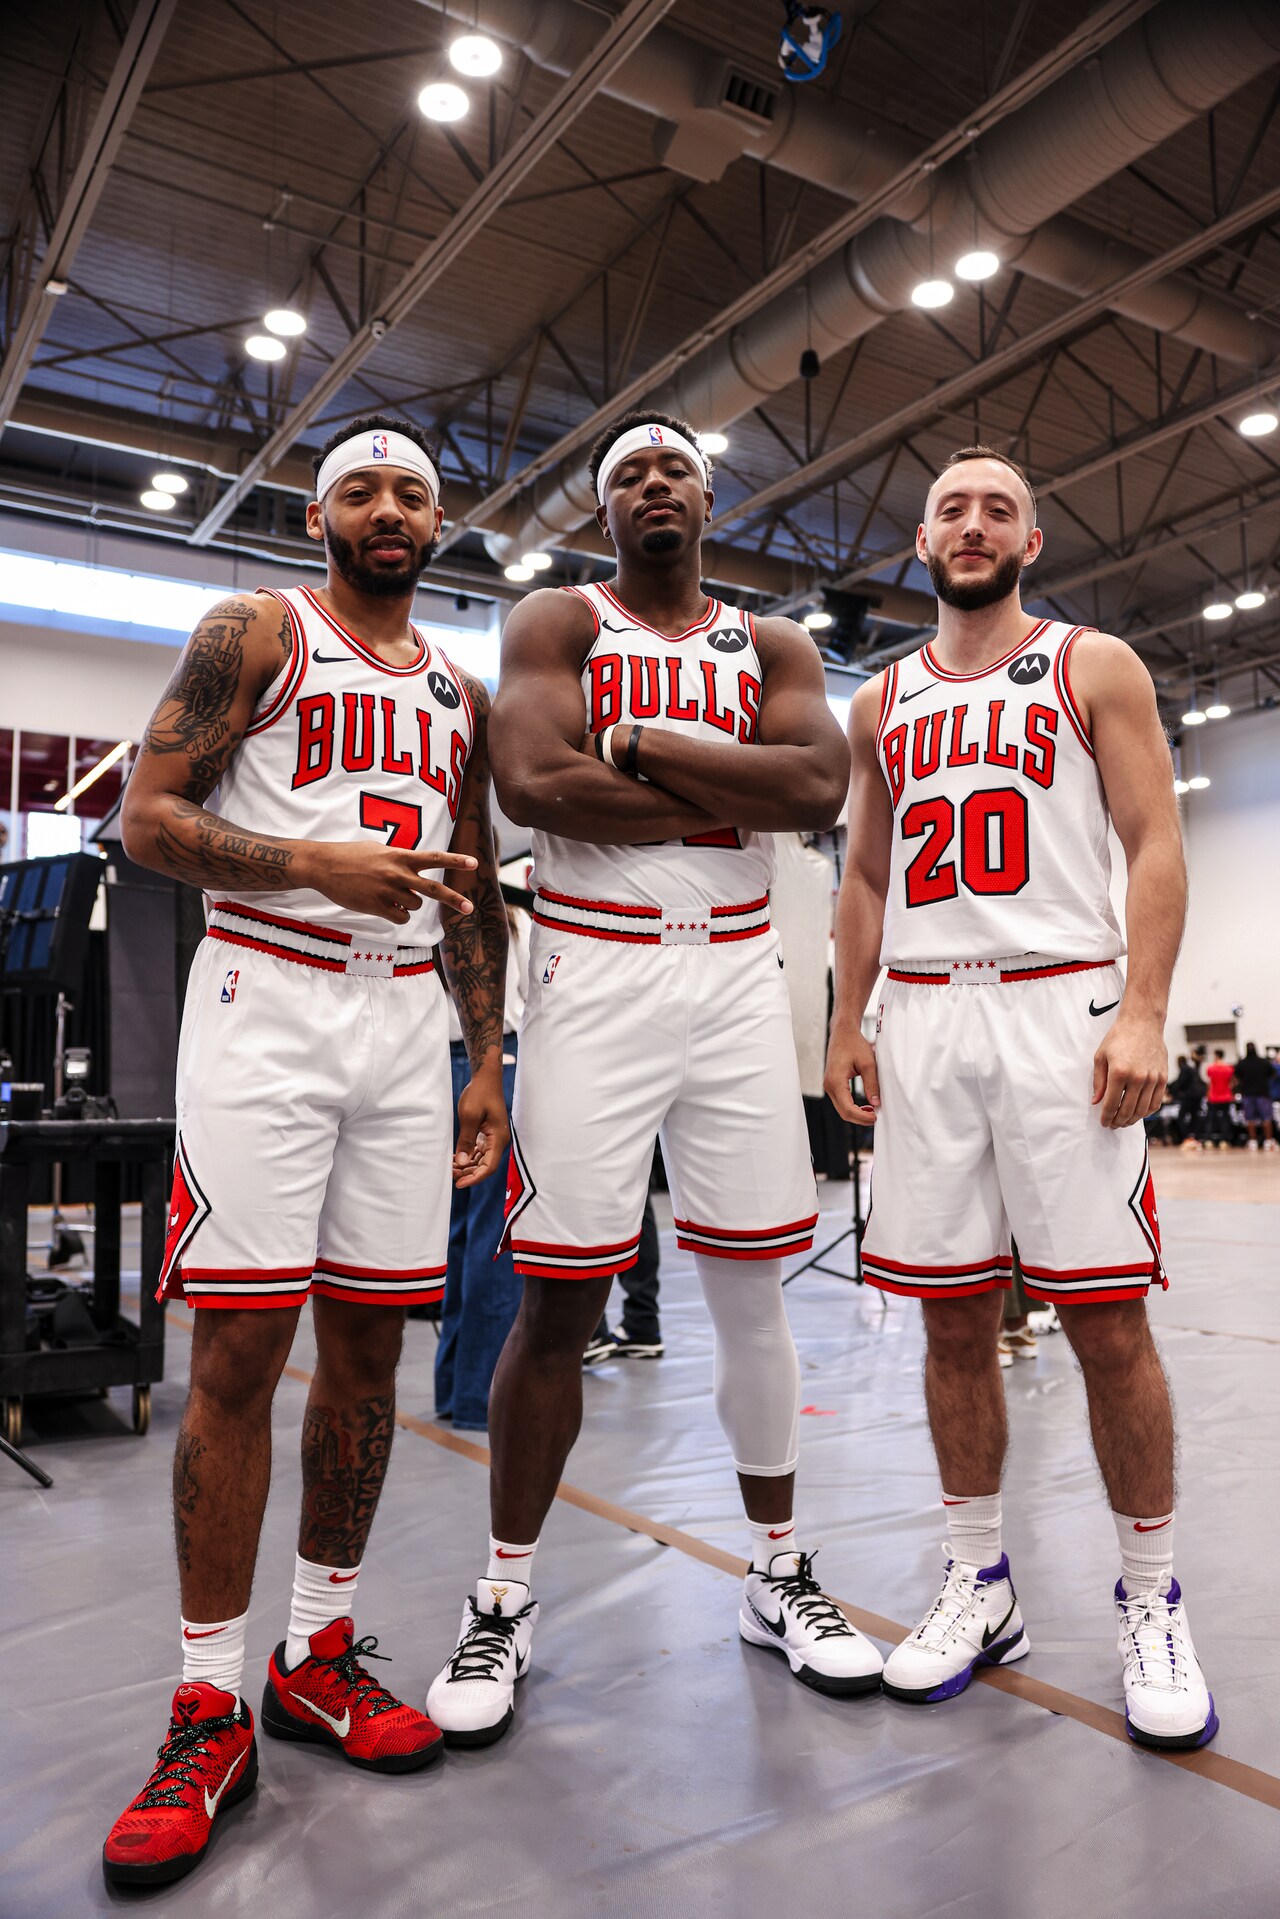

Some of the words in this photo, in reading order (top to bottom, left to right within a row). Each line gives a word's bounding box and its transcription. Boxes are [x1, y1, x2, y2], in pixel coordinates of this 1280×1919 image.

[184, 714, 230, 760] Faith
[589, 653, 762, 744] BULLS
[291, 692, 467, 823] BULLS
[883, 700, 1059, 812] BULLS
[360, 791, 423, 850] 7
[901, 787, 1030, 908] 20
